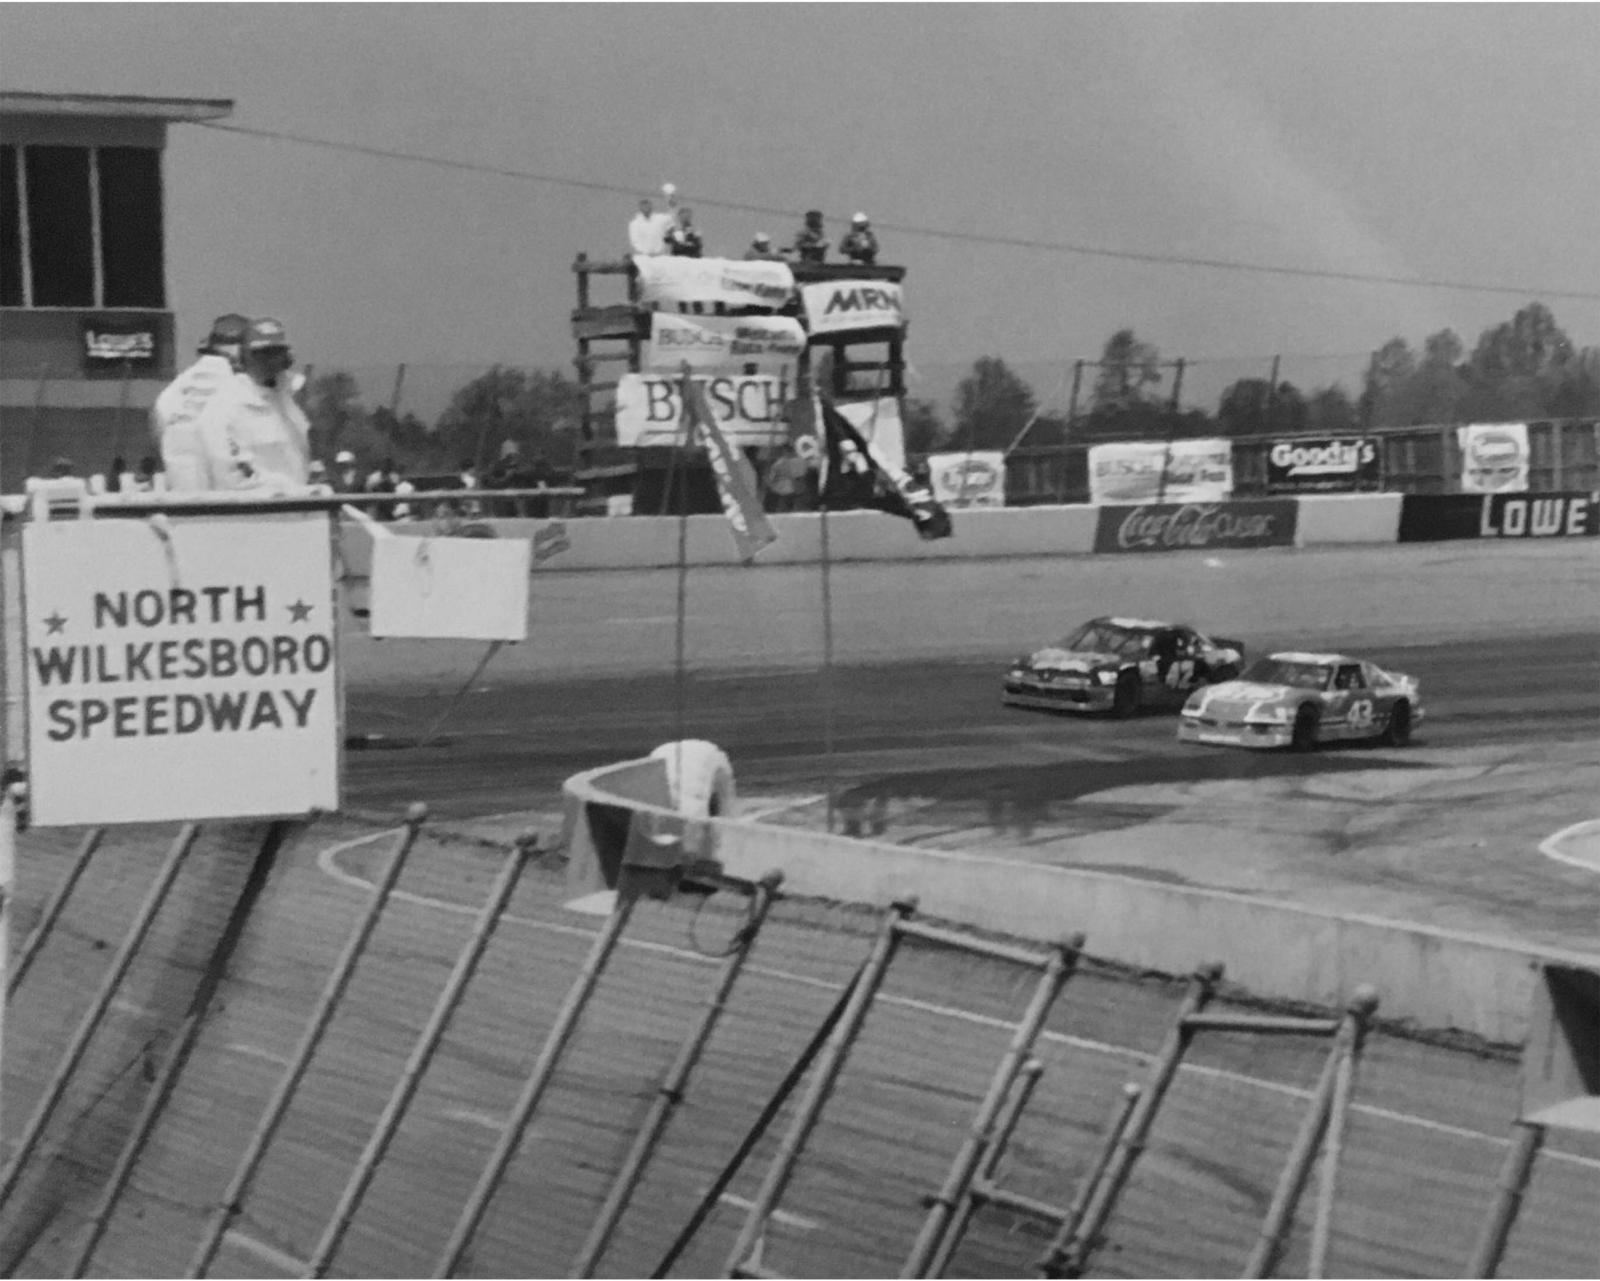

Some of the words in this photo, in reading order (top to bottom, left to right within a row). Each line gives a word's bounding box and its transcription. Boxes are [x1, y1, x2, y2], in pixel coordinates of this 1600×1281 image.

[823, 288, 902, 315] MRN
[1270, 440, 1376, 476] Goody's
[94, 585, 266, 629] NORTH
[33, 634, 331, 685] WILKESBORO
[48, 688, 316, 742] SPEEDWAY
[1347, 699, 1374, 730] 43
